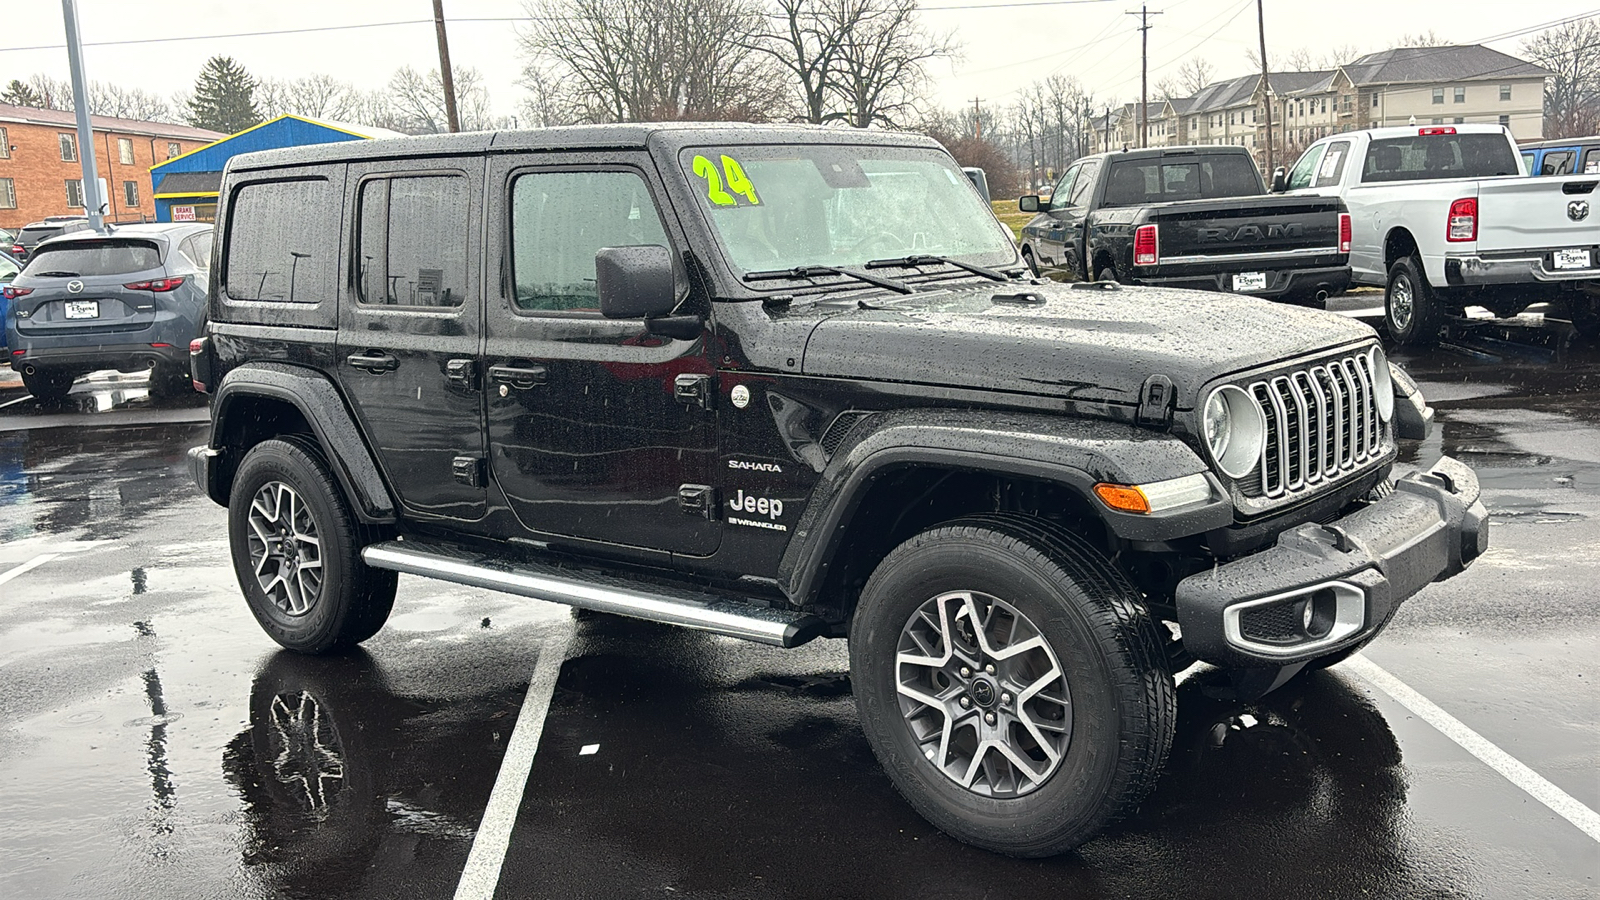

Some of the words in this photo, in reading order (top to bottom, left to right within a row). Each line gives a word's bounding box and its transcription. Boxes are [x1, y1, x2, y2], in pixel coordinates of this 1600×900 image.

[692, 154, 760, 207] 24
[1197, 223, 1303, 243] RAM
[728, 460, 782, 473] SAHARA
[729, 489, 783, 520] Jeep
[736, 518, 787, 532] WRANGLER
